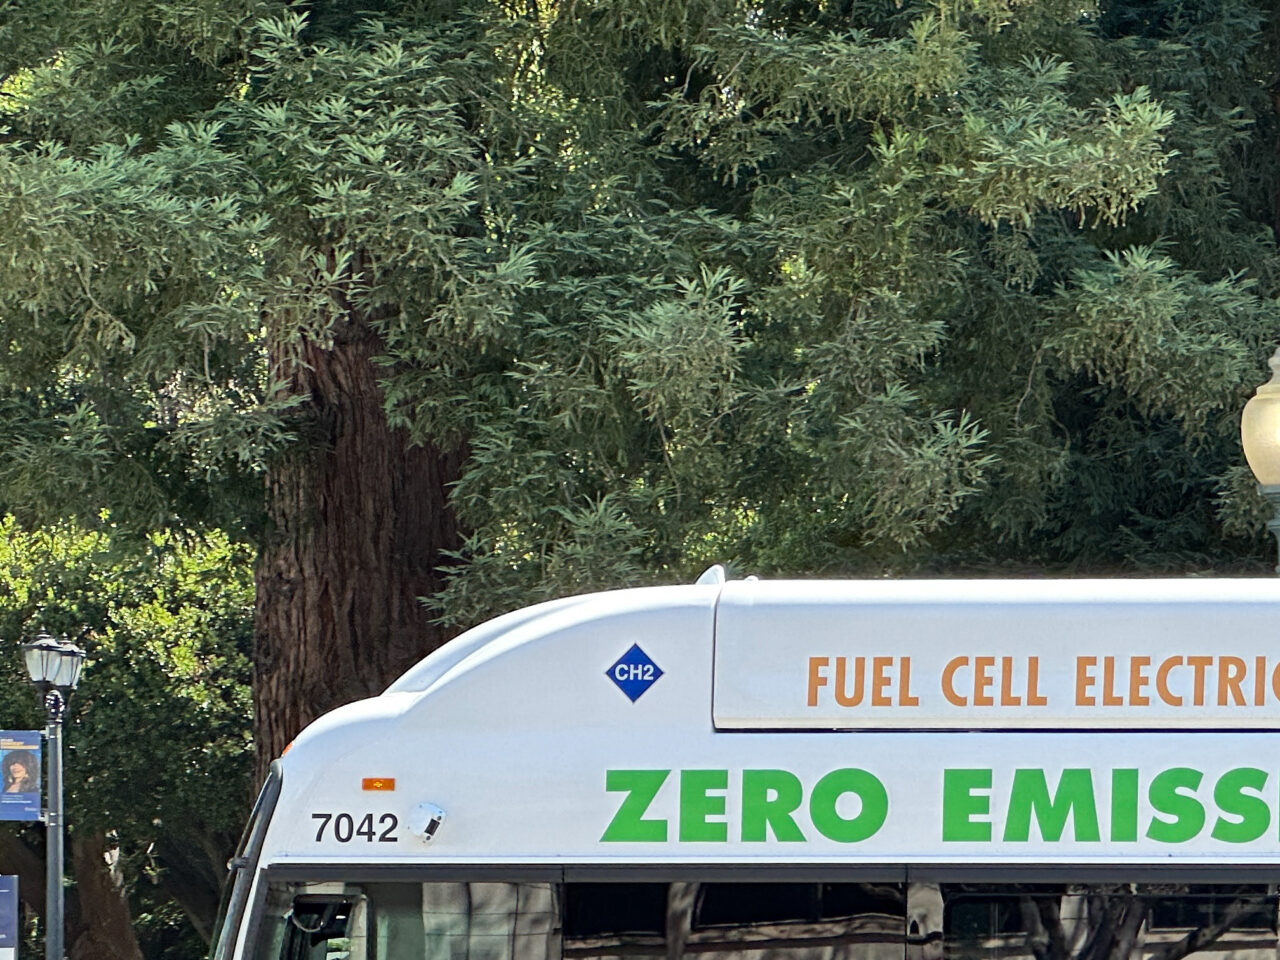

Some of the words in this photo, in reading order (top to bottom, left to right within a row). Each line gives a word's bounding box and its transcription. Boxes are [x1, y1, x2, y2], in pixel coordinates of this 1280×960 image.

[614, 663, 655, 681] CH2
[807, 656, 919, 707] FUEL
[941, 656, 1047, 707] CELL
[600, 767, 889, 844] ZERO
[310, 812, 398, 843] 7042
